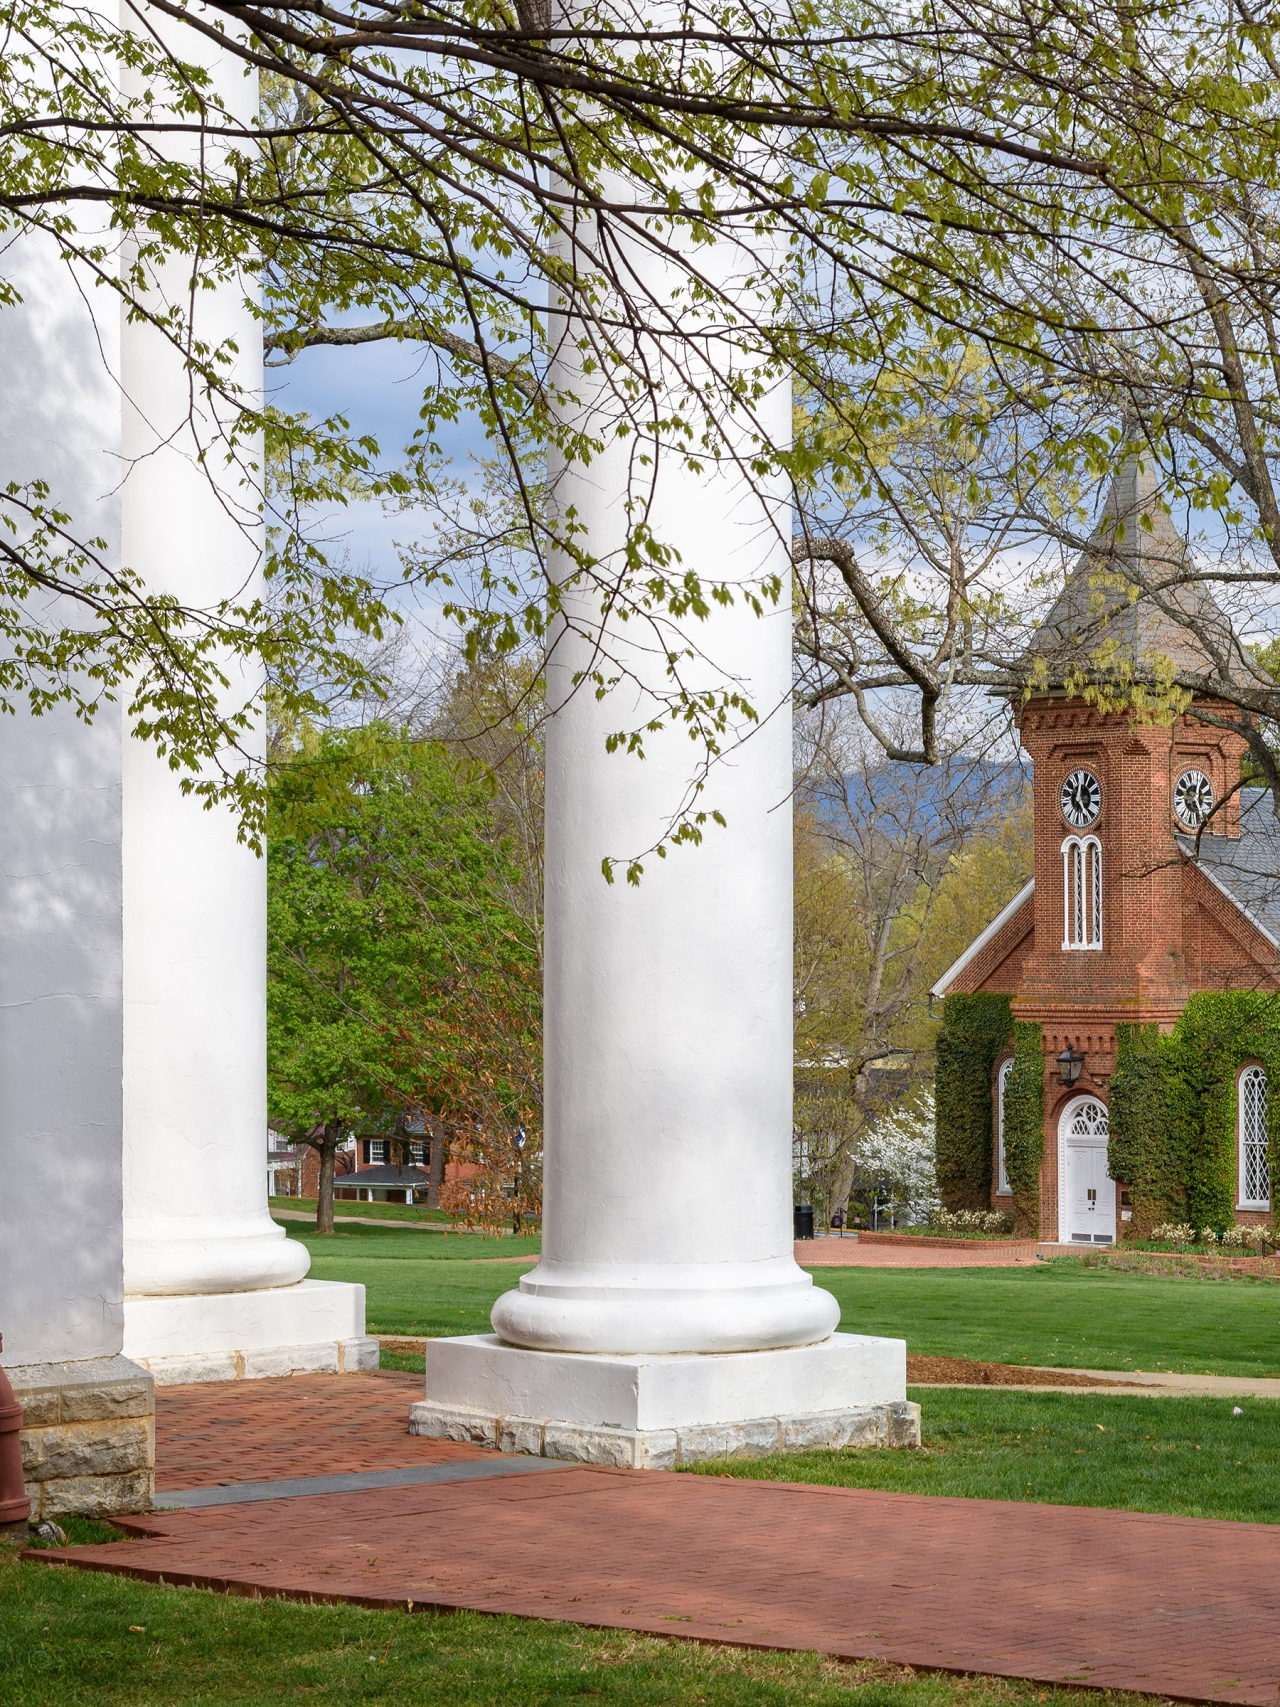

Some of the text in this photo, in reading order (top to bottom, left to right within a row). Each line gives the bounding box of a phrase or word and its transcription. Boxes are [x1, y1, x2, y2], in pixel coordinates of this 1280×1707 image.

[1085, 774, 1090, 787] I
[1089, 783, 1099, 793] II
[1090, 794, 1101, 802] III
